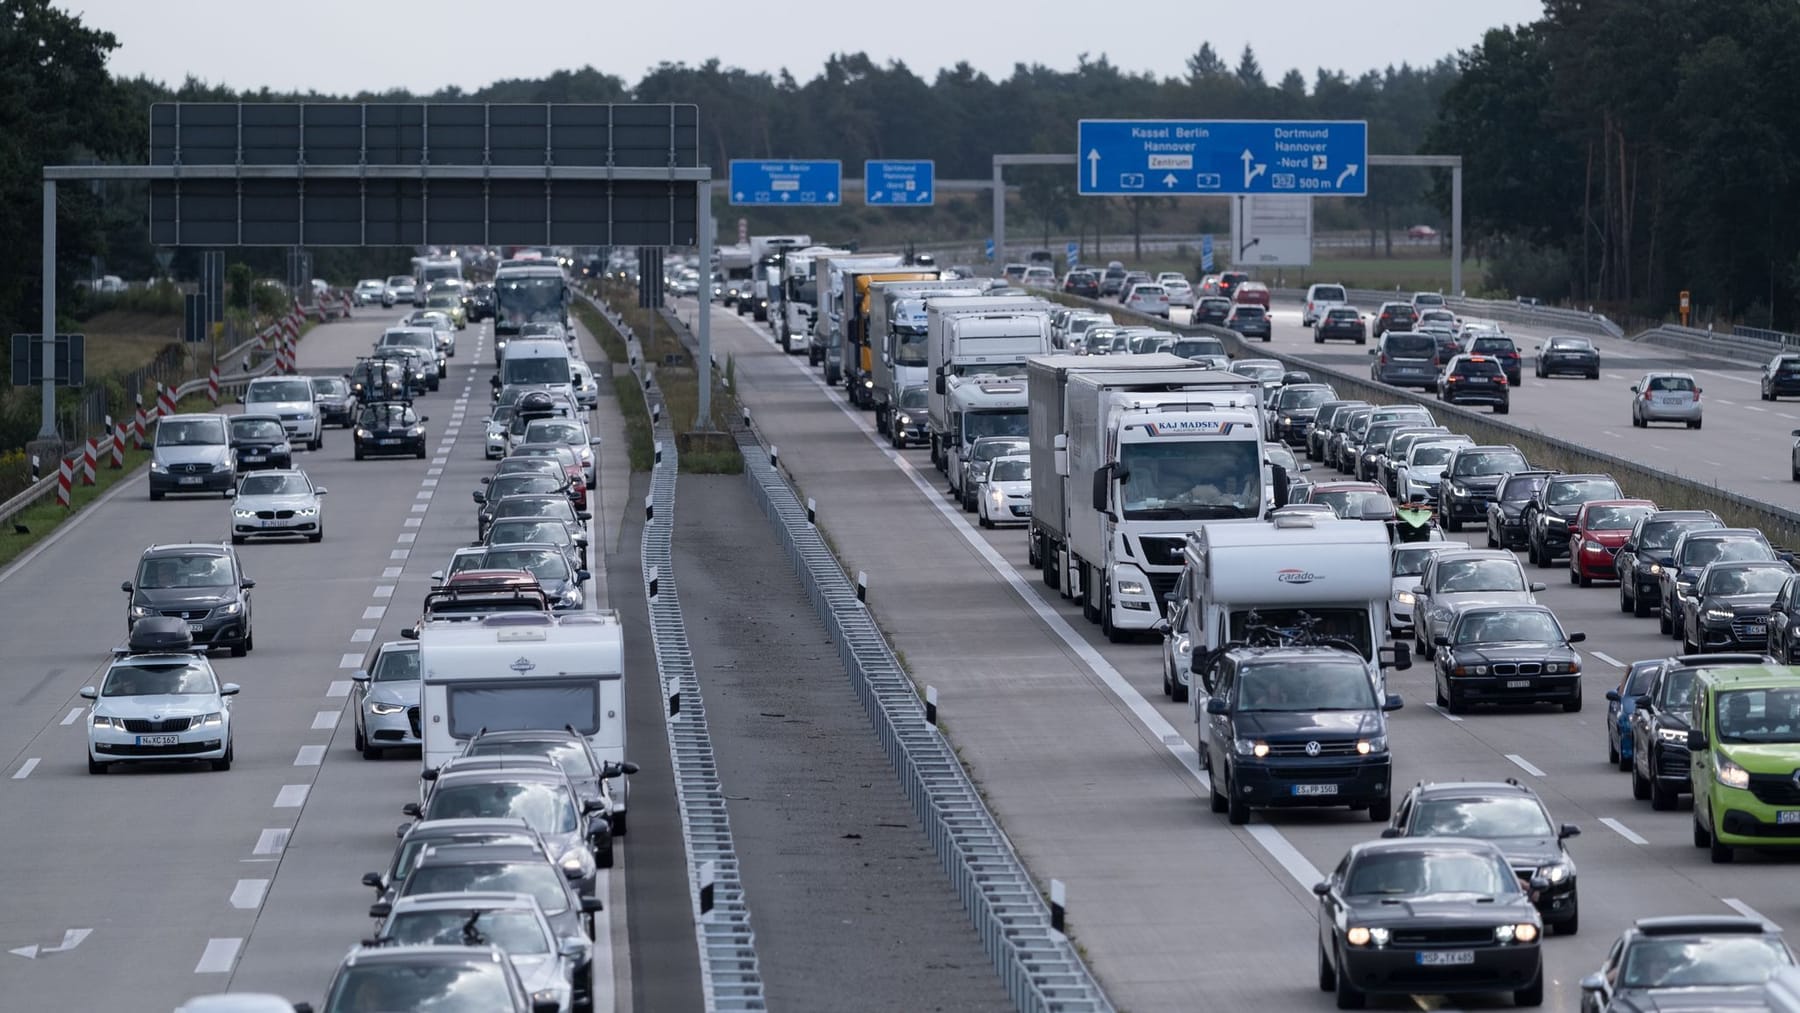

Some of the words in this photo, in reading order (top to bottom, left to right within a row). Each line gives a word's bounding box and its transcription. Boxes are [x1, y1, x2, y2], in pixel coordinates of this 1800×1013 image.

[1132, 127, 1169, 138] Kassel
[1176, 127, 1209, 138] Berlin
[1274, 127, 1329, 139] Dortmund
[1144, 141, 1196, 152] Hannover
[1275, 141, 1327, 152] Hannover
[1151, 157, 1190, 167] Zentrum
[1276, 157, 1309, 168] -Nord
[1299, 178, 1319, 189] 500
[1180, 421, 1219, 429] MADSEN
